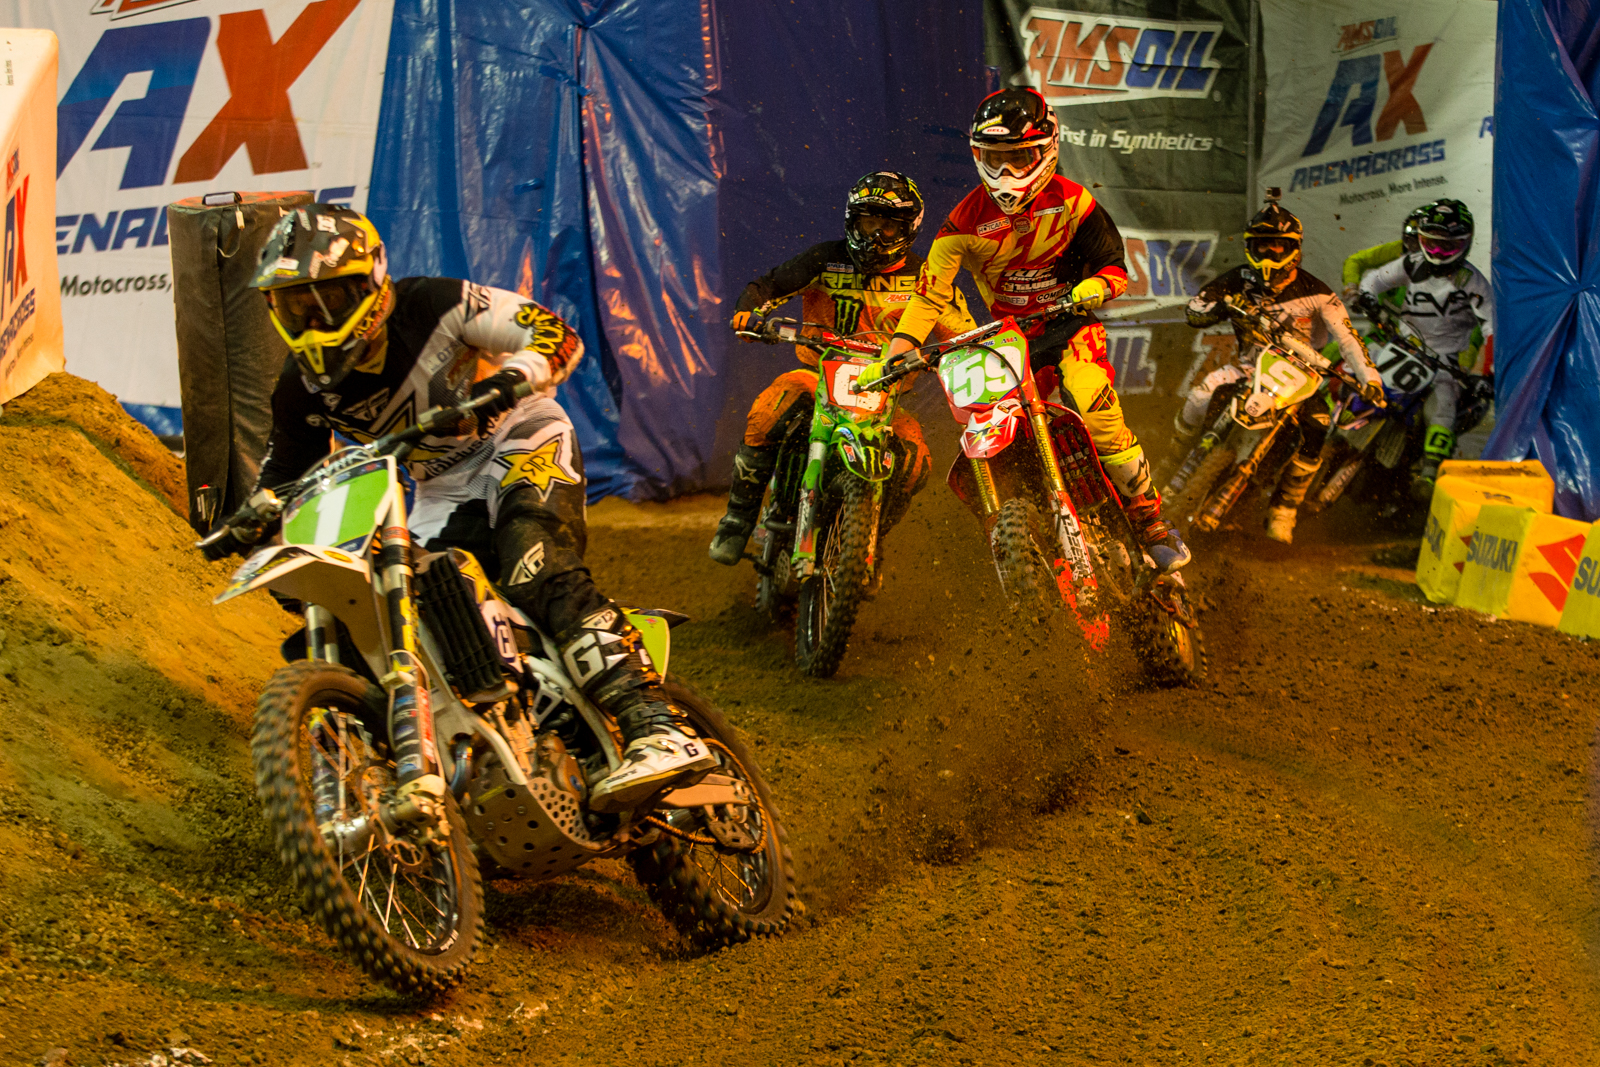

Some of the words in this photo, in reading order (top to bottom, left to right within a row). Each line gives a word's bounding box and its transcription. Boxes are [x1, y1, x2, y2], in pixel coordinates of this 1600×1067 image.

[1026, 17, 1215, 97] AMSOIL
[1337, 16, 1397, 51] AMSOIL
[1302, 42, 1434, 158] AX
[1089, 129, 1107, 148] in
[1109, 129, 1214, 154] Synthetics
[1288, 138, 1447, 193] ARENACROSS
[953, 345, 1022, 408] 59
[1377, 347, 1429, 392] 76
[313, 484, 351, 547] 1
[1466, 530, 1519, 573] SUZUKI
